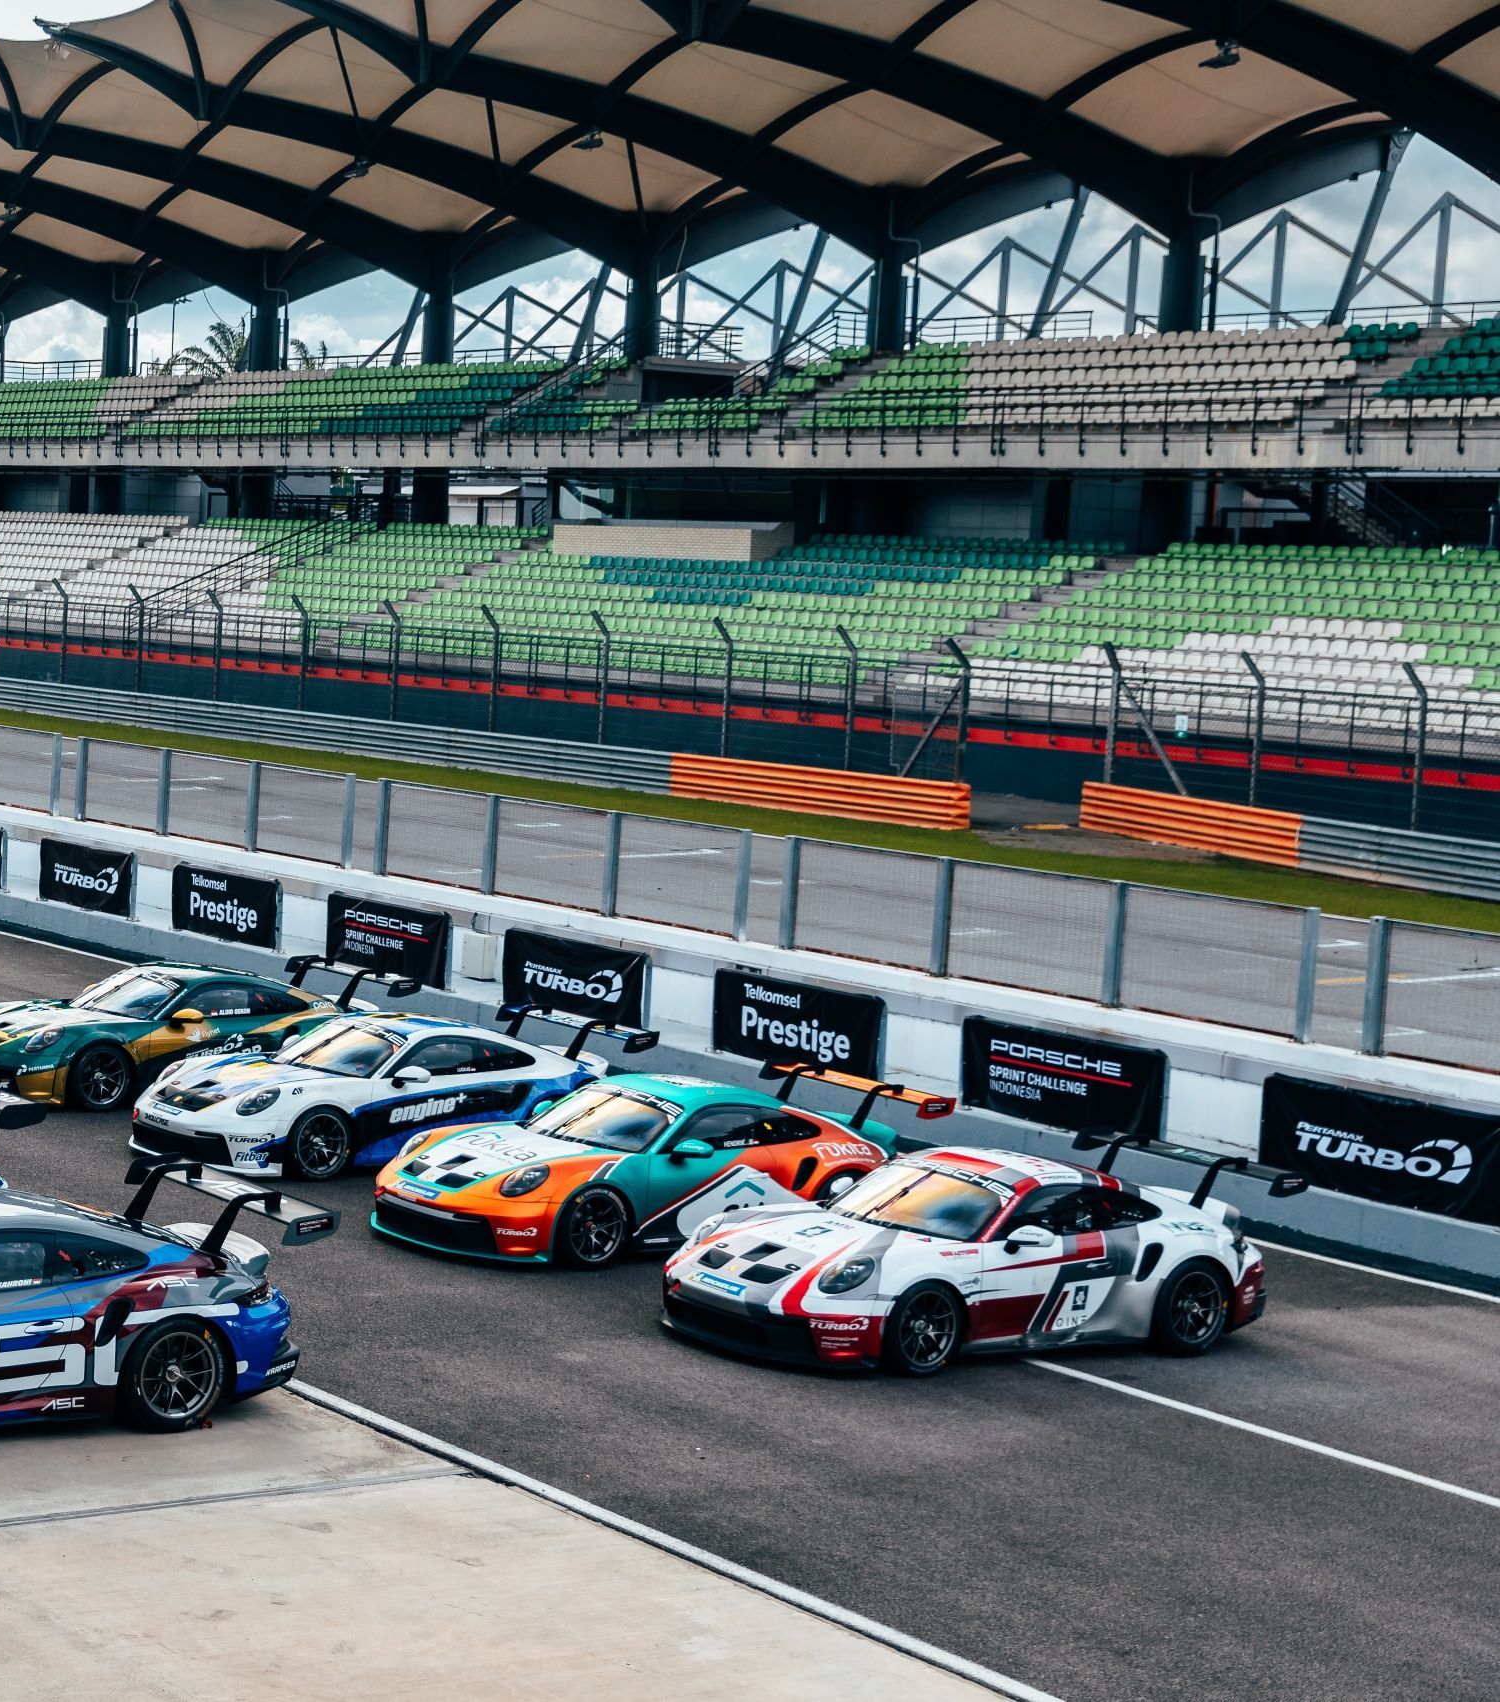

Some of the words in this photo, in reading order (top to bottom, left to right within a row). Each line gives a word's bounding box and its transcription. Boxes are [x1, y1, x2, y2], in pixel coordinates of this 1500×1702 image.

[54, 868, 108, 893] TURBO
[191, 873, 227, 892] Telkomsel
[190, 891, 258, 933] Prestige
[344, 909, 423, 936] PORSCHE
[344, 940, 375, 957] INDONESIA
[345, 929, 365, 944] SPRINT
[365, 934, 404, 951] CHALLENGE
[525, 960, 563, 976] PERTAMAX
[523, 967, 607, 1000] TURBO
[744, 983, 801, 1009] Telkomsel
[740, 1006, 850, 1064] Prestige
[27, 1064, 55, 1073] PERTAMINA
[990, 1038, 1122, 1078] PORSCHE
[989, 1064, 1025, 1084] SPRINT
[1026, 1072, 1088, 1097] CHALLENGE
[989, 1079, 1042, 1102] INDONESIA
[1296, 1120, 1364, 1143] PERTAMAX
[234, 1151, 269, 1162] Fitbar
[1295, 1129, 1442, 1178] TURBO
[496, 1228, 530, 1236] TURBO
[810, 1321, 858, 1331] TURBO
[41, 1396, 86, 1411] ASC
